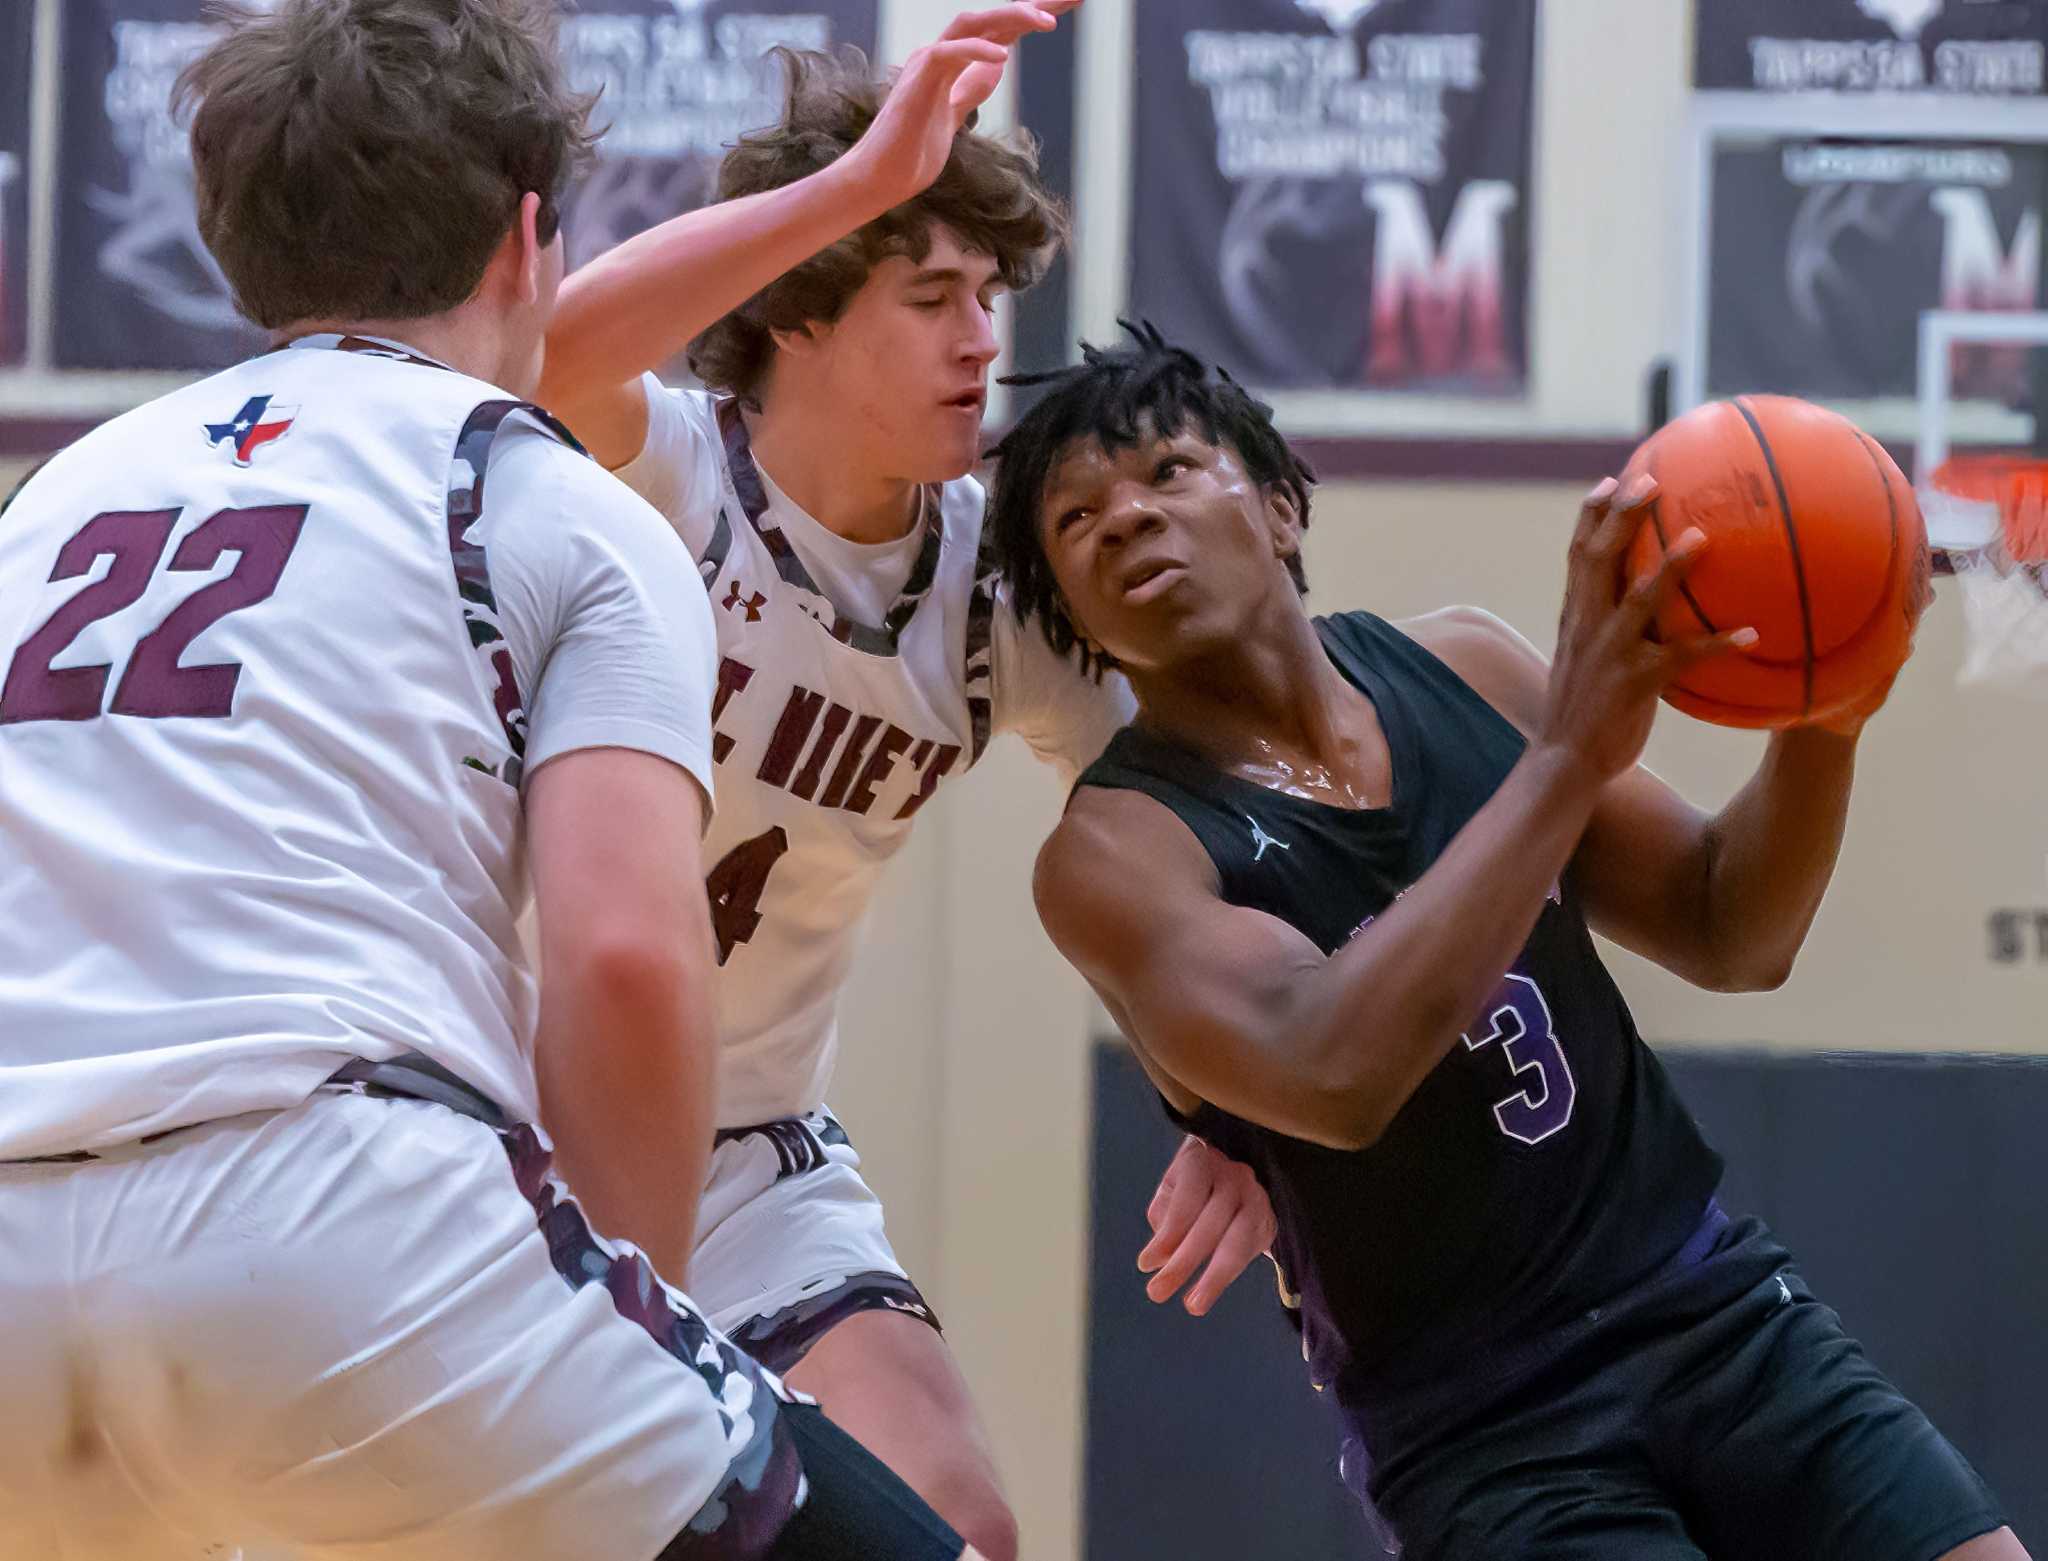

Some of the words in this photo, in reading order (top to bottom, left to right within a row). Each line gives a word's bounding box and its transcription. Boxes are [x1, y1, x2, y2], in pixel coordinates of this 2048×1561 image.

[1363, 179, 1519, 388] M
[0, 504, 310, 726] 22
[706, 826, 788, 967] 4
[1462, 973, 1576, 1145] 3
